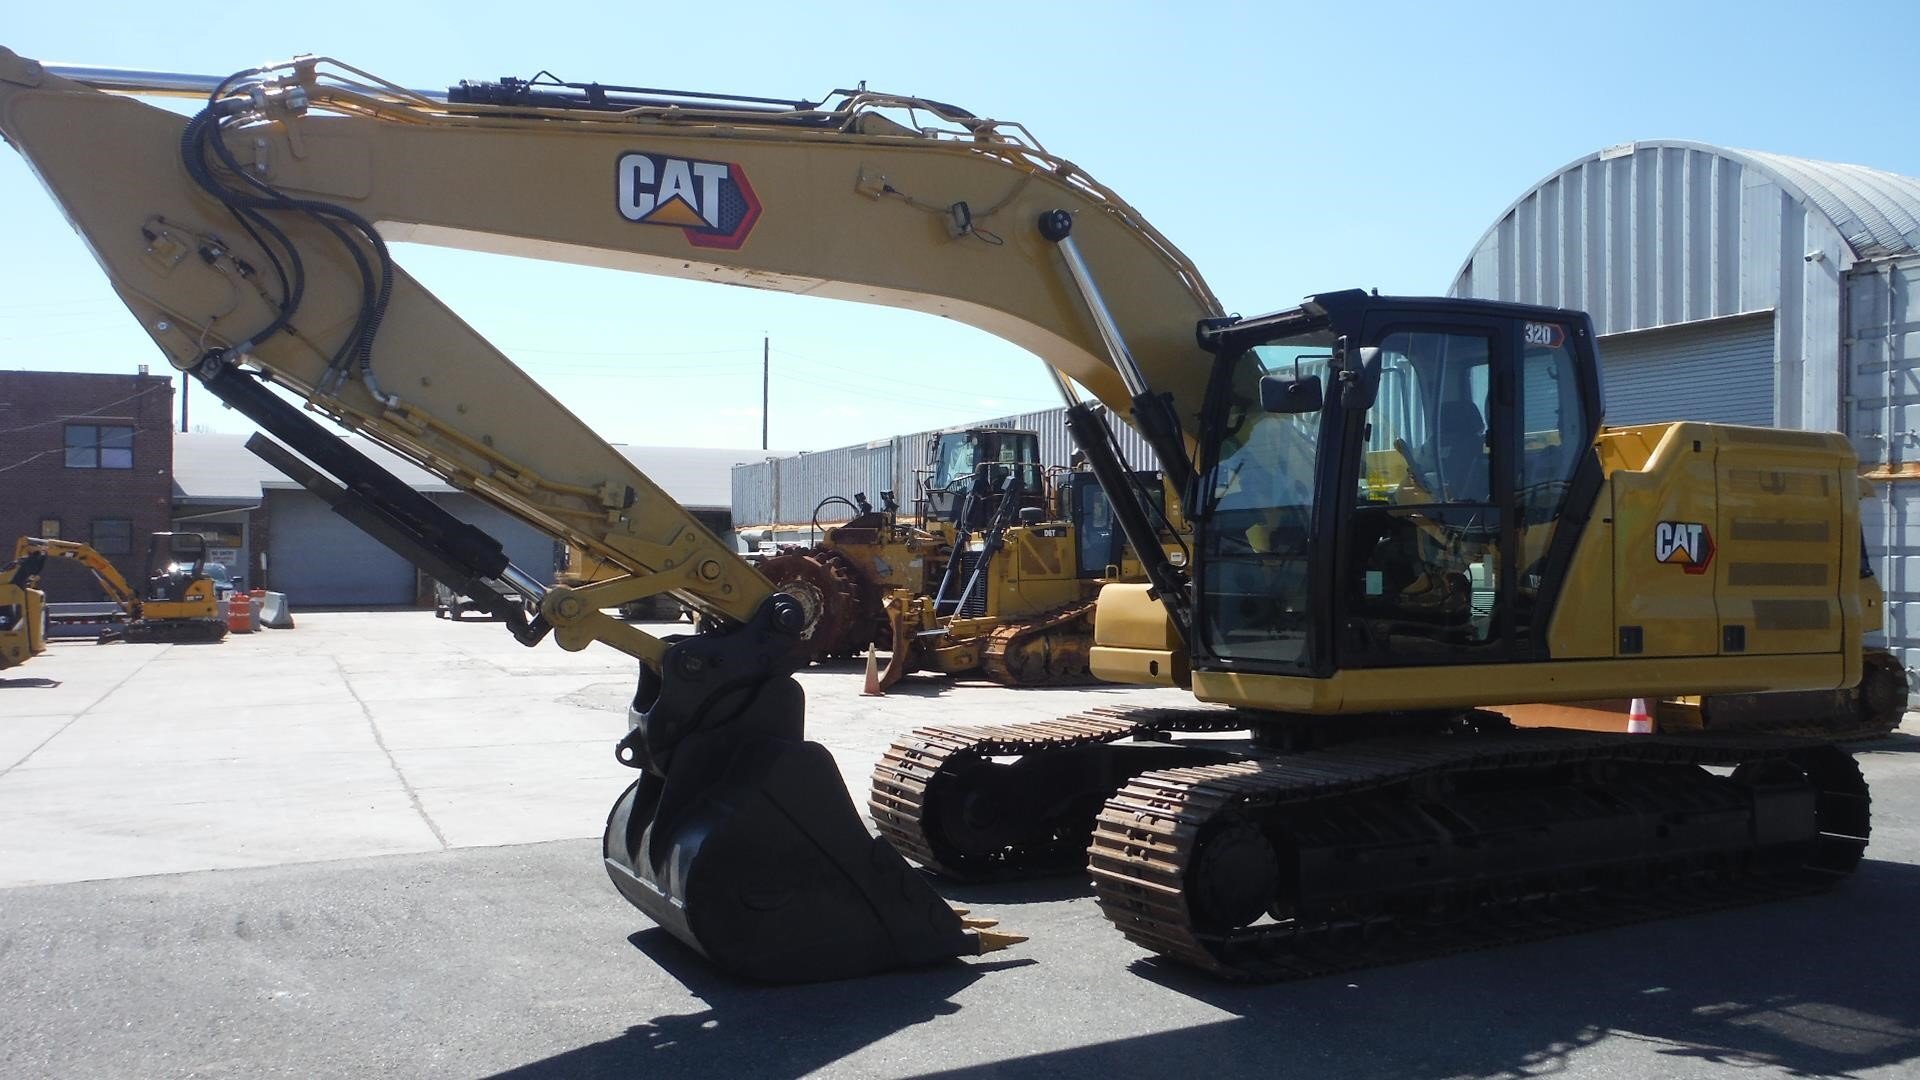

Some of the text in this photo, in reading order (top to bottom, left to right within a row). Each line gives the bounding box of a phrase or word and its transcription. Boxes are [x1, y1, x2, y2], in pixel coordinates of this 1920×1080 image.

[619, 153, 728, 229] CAT
[1525, 323, 1551, 345] 320
[1656, 522, 1703, 563] CAT
